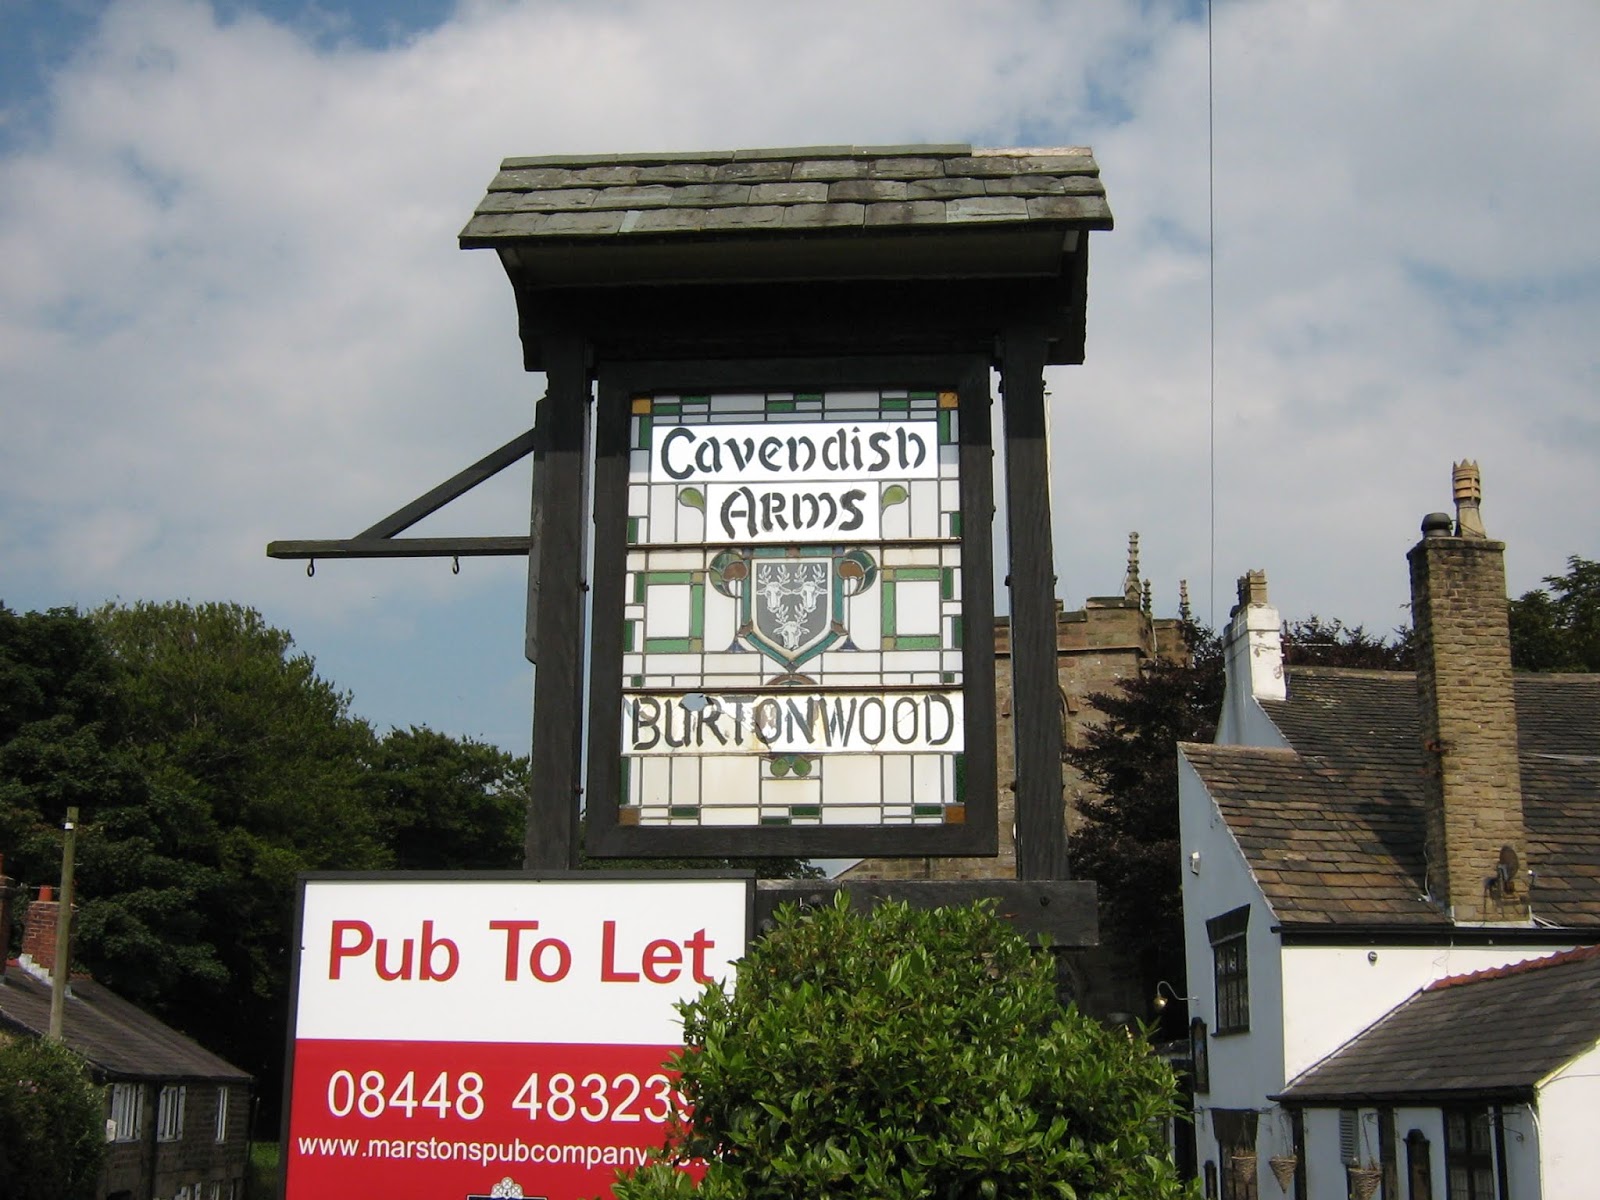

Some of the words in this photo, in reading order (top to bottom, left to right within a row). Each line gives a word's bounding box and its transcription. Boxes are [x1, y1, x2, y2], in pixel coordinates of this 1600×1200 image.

[661, 427, 926, 480] Cavendish
[633, 694, 954, 751] BURTONWOOD
[328, 920, 460, 982] Pub
[489, 920, 572, 983] To
[600, 920, 716, 984] Let
[327, 1070, 485, 1120] 08448
